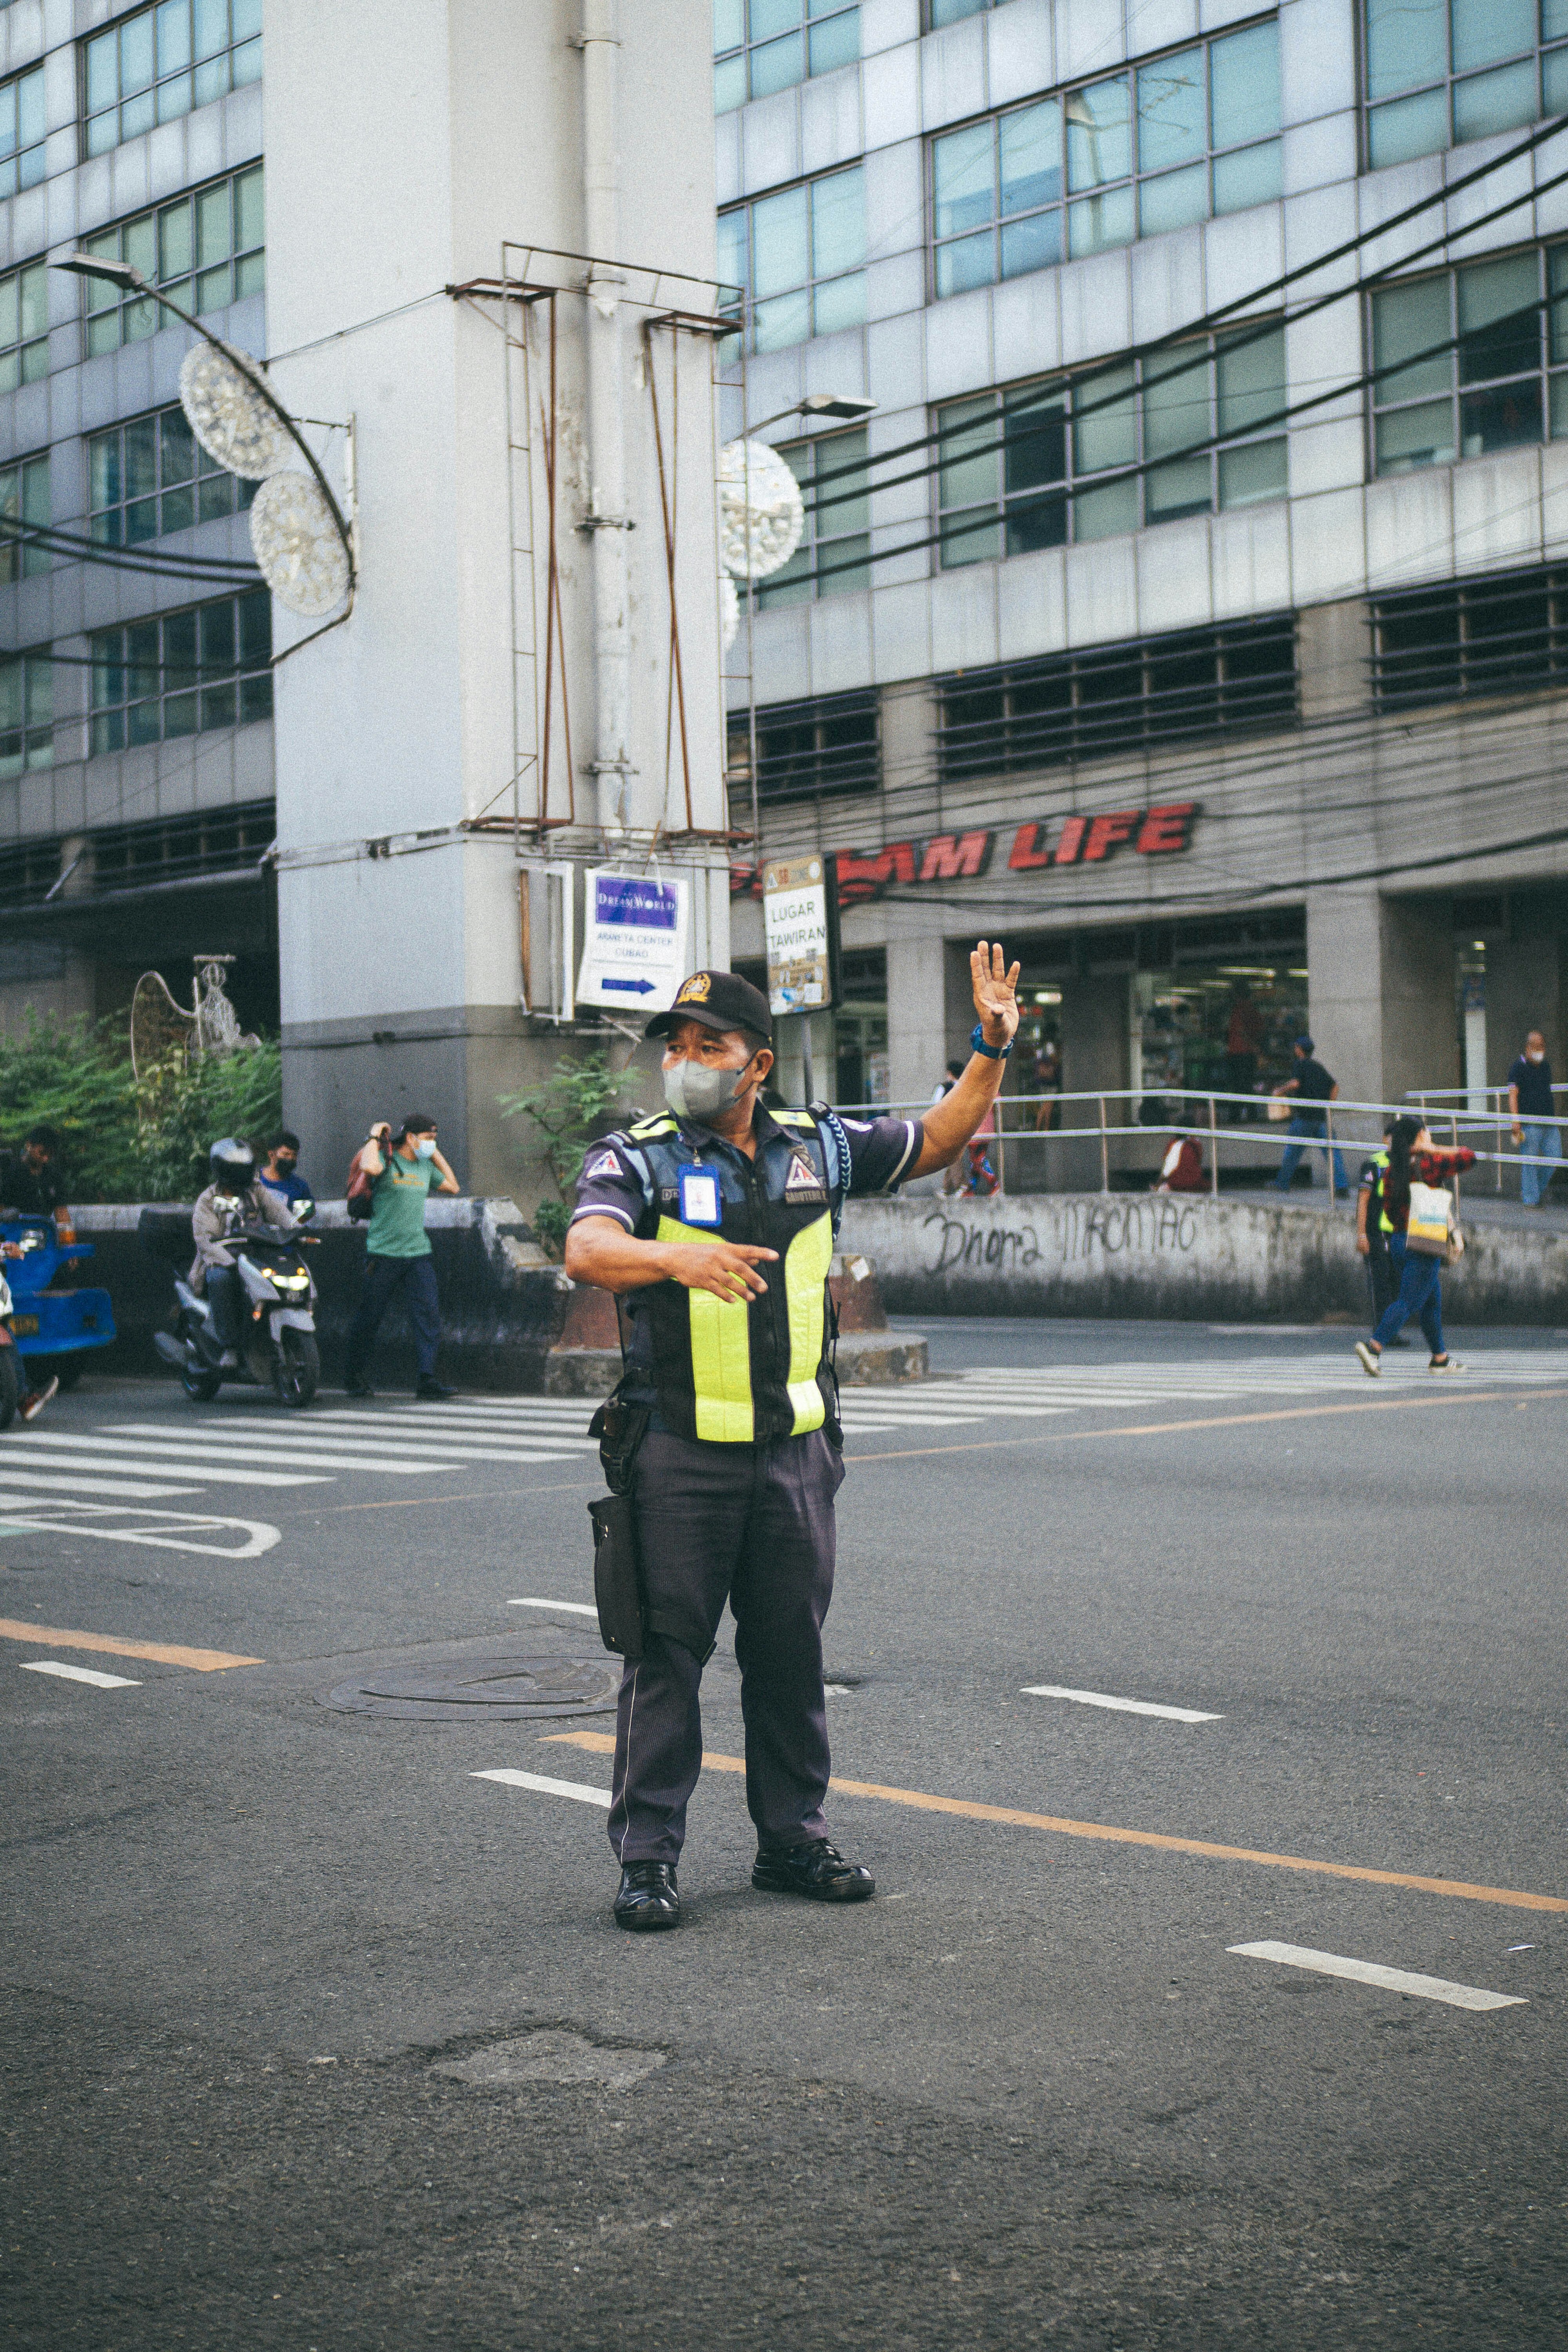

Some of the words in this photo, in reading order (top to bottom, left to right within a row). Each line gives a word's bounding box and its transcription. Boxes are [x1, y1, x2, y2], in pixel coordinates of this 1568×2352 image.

[1007, 802, 1196, 870] LIFE
[771, 901, 815, 923] LUGAR
[597, 932, 633, 942] ARANETA
[637, 934, 673, 946] CENTER
[770, 926, 825, 949] TAWIRAN
[615, 947, 648, 958] CUBAO
